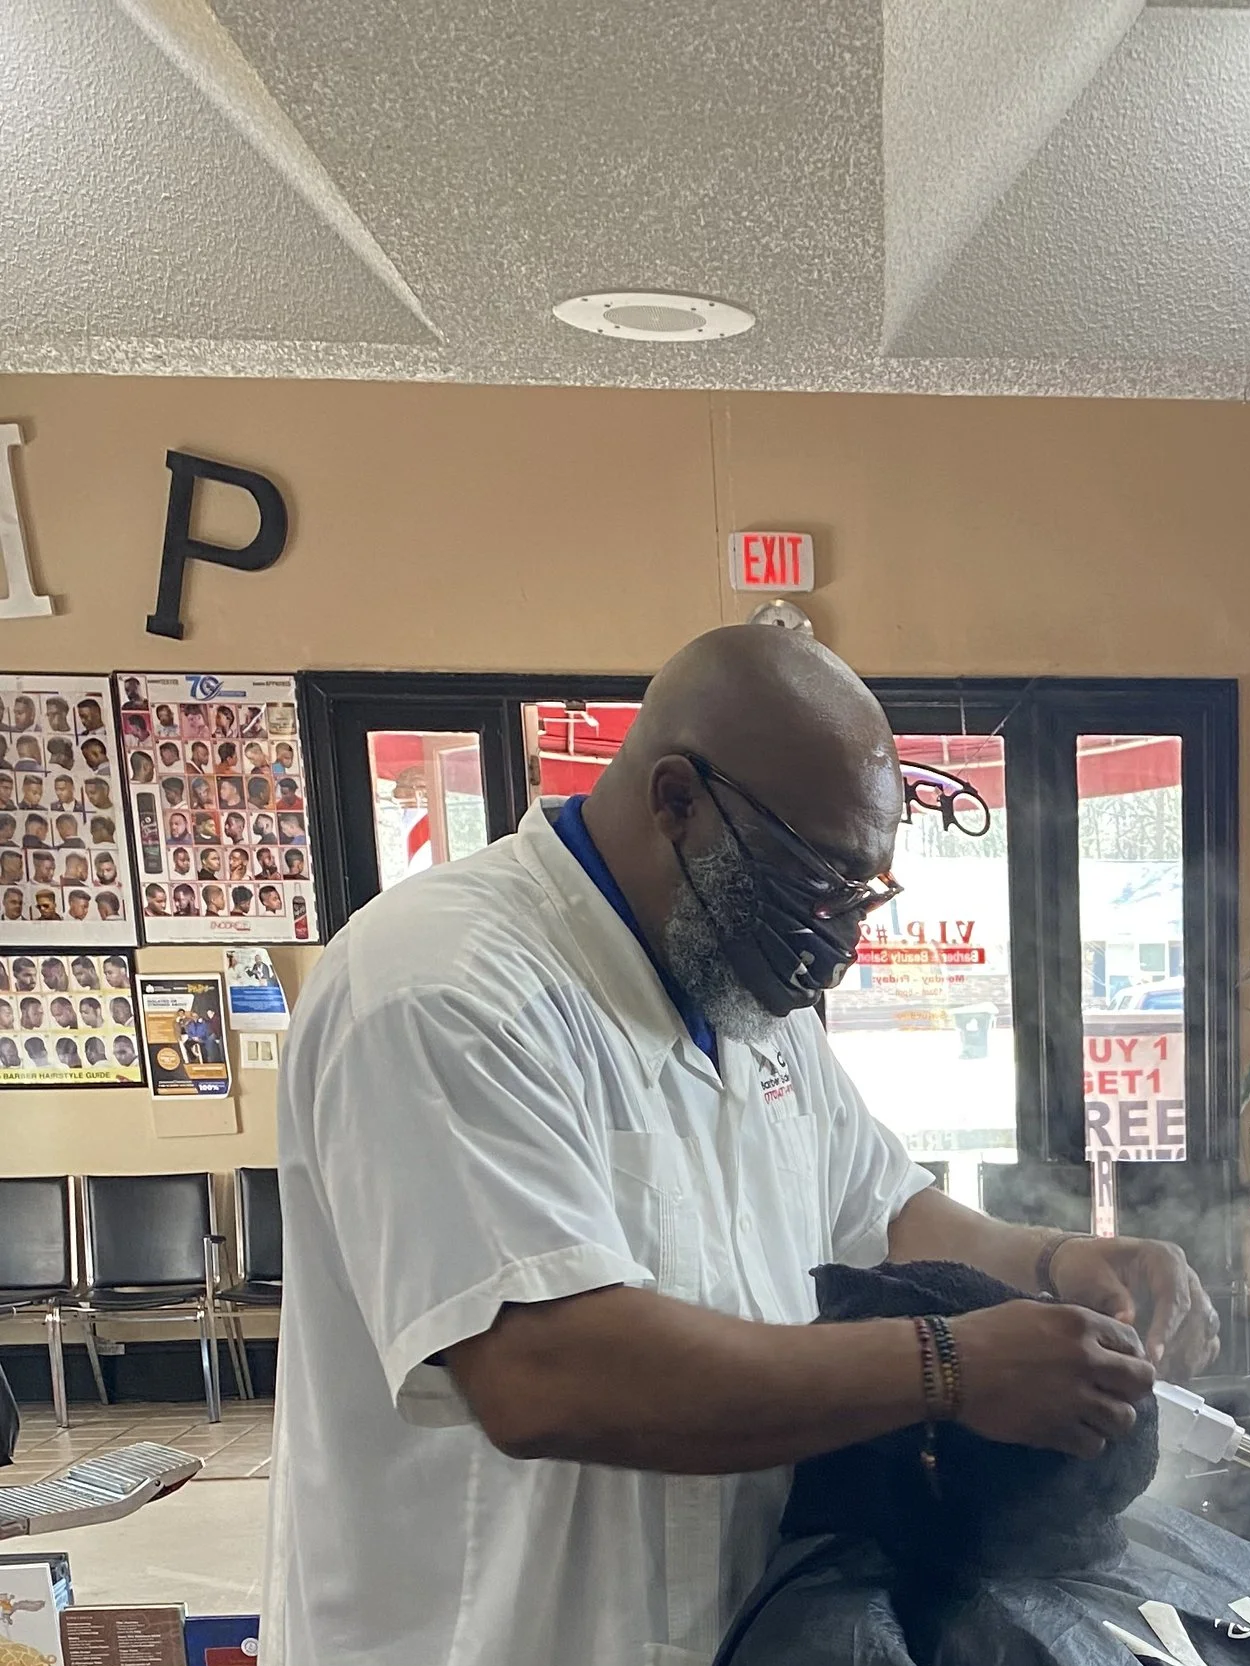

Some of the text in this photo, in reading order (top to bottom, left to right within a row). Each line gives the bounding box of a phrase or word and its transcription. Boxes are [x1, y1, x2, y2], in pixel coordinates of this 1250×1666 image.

[743, 535, 803, 585] EXIT
[1083, 1036, 1168, 1063] UY 1
[39, 1071, 85, 1080] HAIRSTYLE
[86, 1071, 111, 1079] GUIDE
[1084, 1099, 1185, 1147] REE
